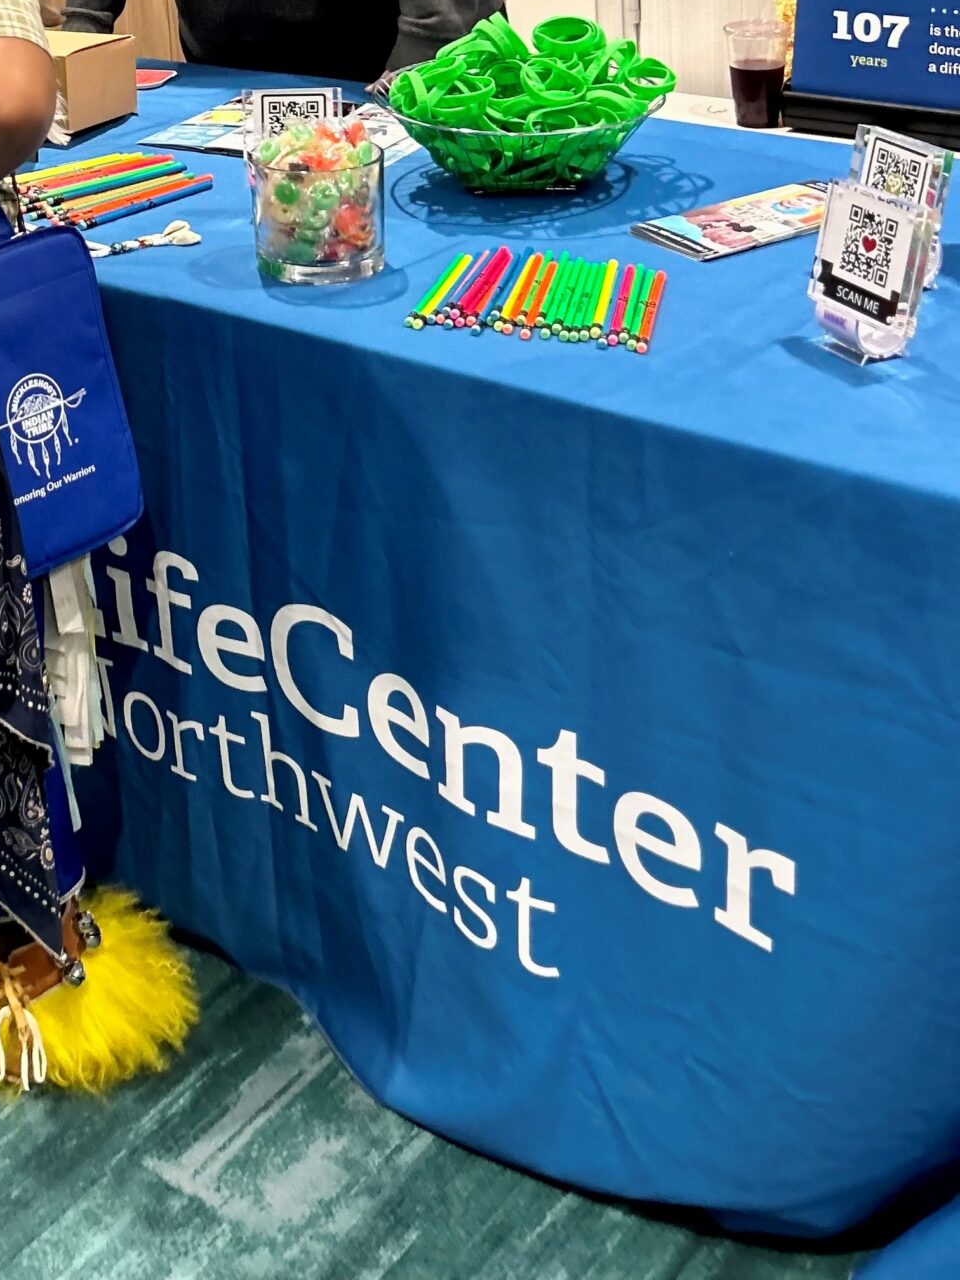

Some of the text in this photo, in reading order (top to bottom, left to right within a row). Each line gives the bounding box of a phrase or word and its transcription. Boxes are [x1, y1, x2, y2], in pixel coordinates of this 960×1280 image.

[832, 9, 910, 48] 107
[929, 24, 960, 38] is th
[851, 53, 888, 68] years
[928, 63, 937, 73] a
[836, 285, 880, 315] SCAN ME
[11, 379, 58, 413] MUCKLESHOOT
[21, 409, 55, 431] INDIAN
[25, 420, 54, 439] TRIBE
[13, 464, 96, 506] onoring Our Warriors
[94, 535, 796, 952] ifeCenter
